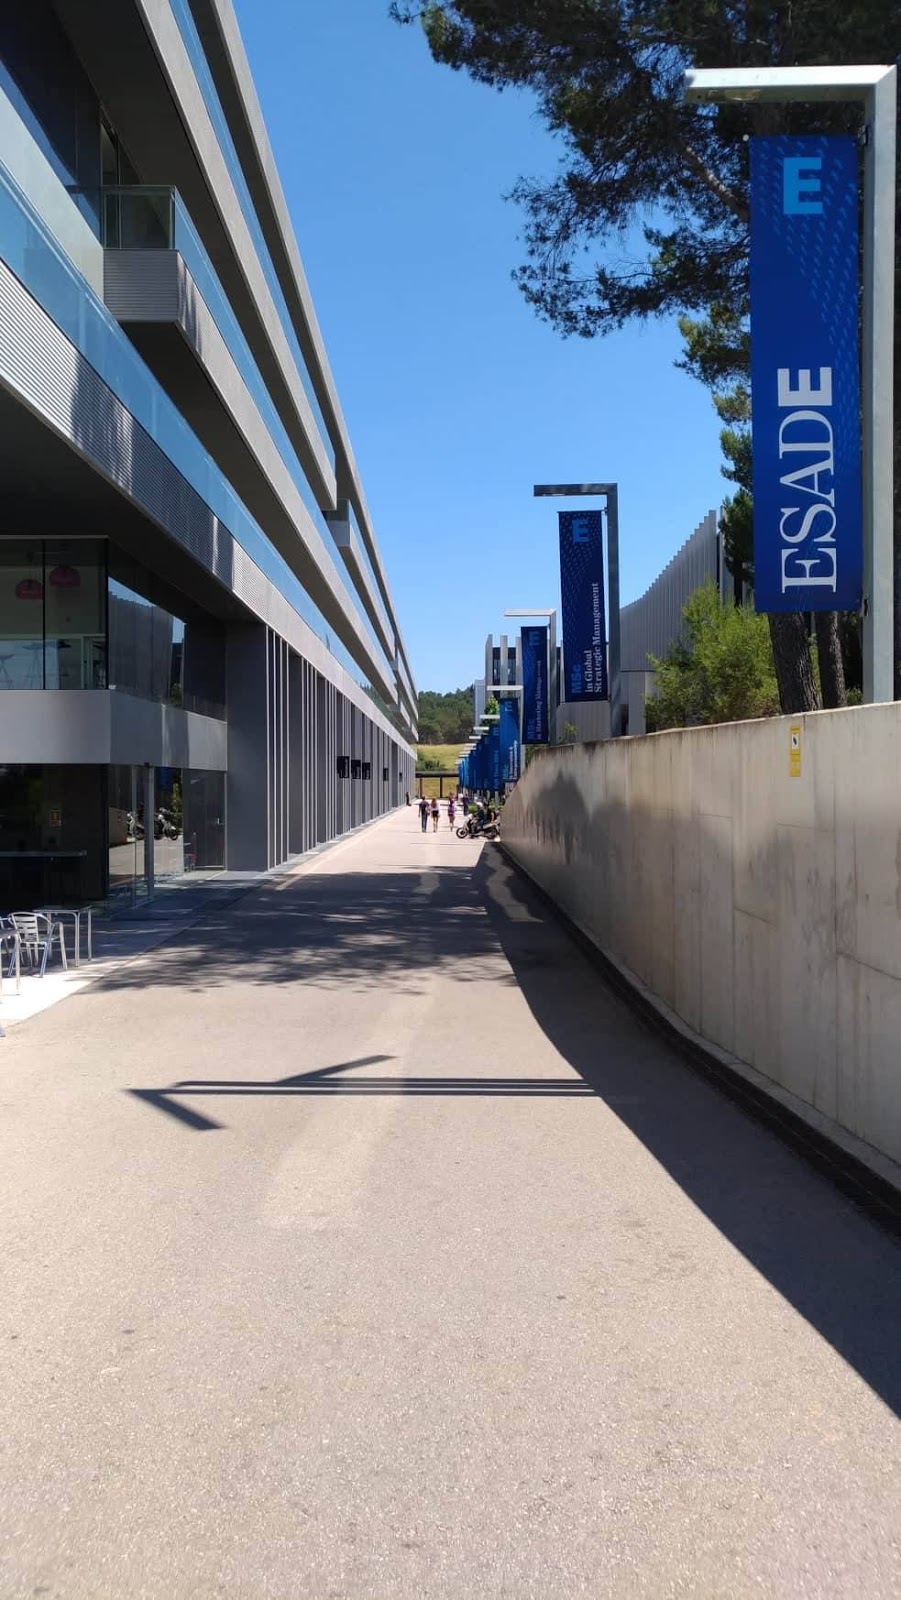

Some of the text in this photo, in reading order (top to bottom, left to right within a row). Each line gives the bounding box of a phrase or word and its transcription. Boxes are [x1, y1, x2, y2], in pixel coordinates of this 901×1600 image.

[783, 157, 823, 215] E
[777, 366, 838, 594] ESADE
[572, 519, 590, 543] E
[591, 582, 603, 693] Strategic Management
[571, 664, 582, 694] MSc
[583, 649, 593, 693] in Global
